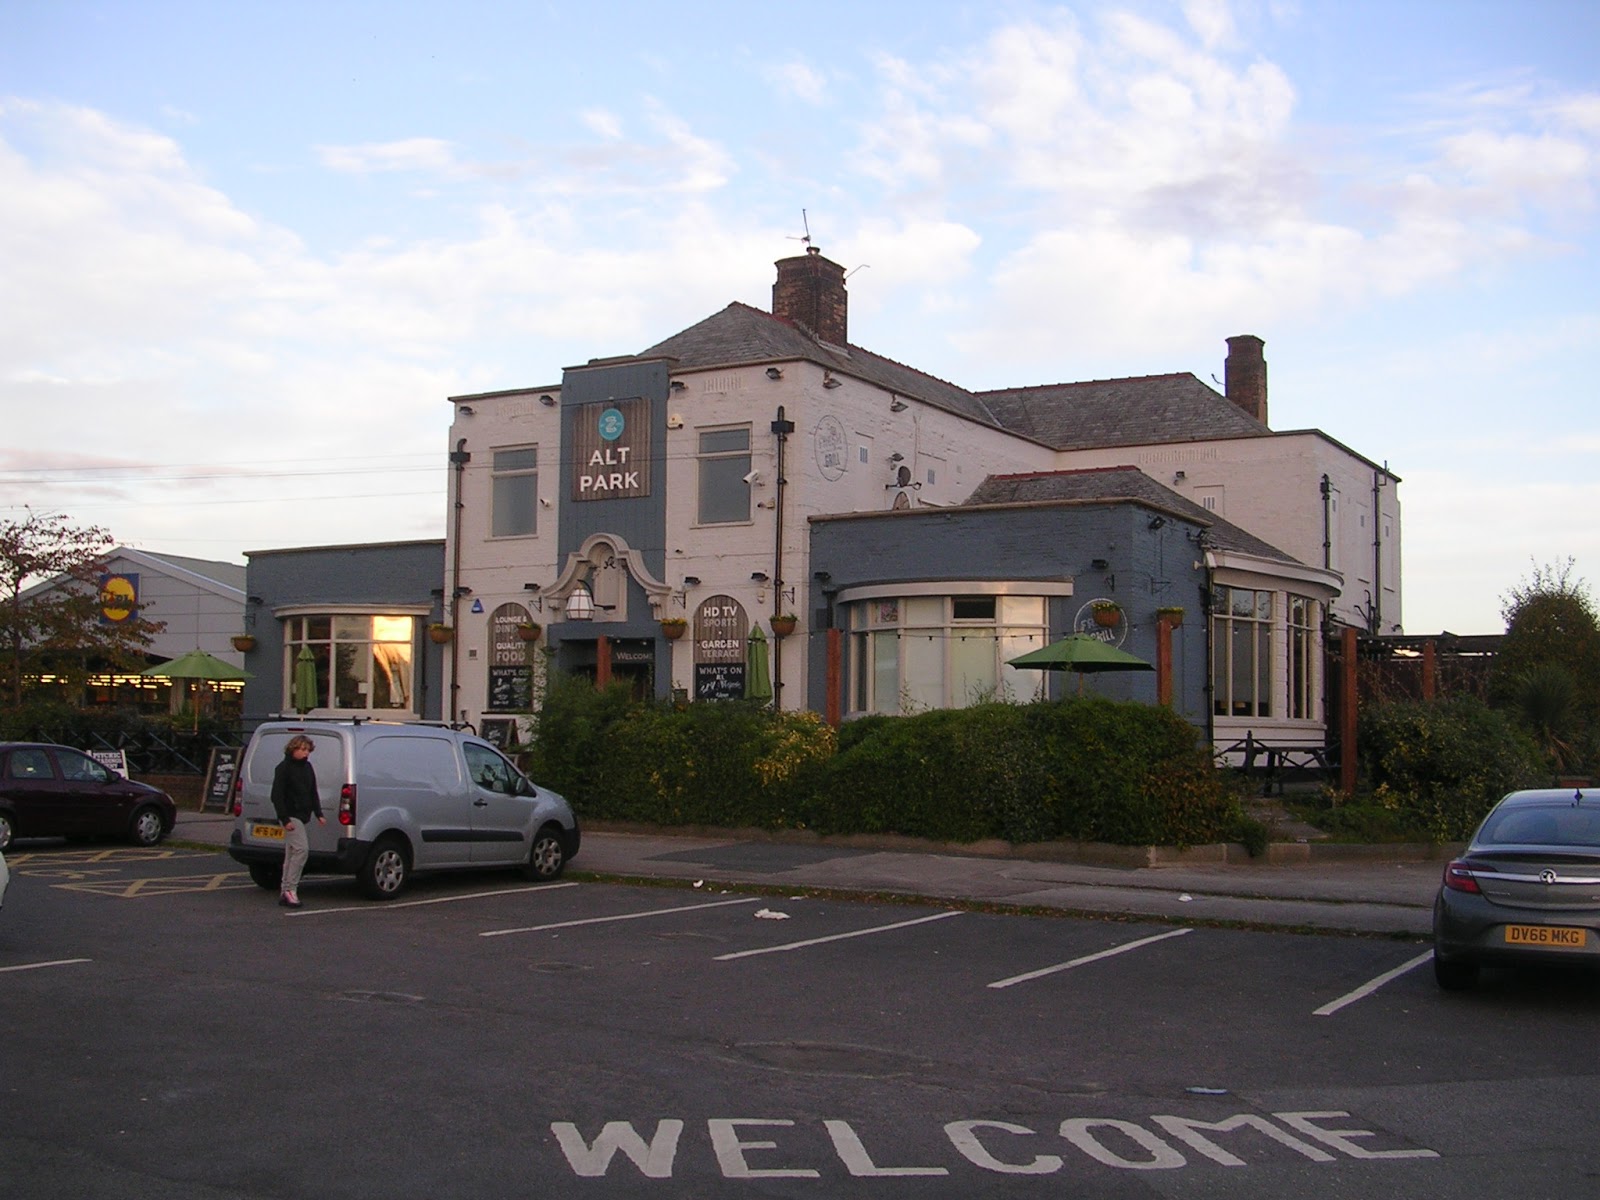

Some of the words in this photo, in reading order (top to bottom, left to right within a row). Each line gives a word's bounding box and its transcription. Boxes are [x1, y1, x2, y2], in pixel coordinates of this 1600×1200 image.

[588, 446, 630, 467] ALT
[580, 471, 639, 493] PARK
[703, 606, 720, 618] HD
[722, 605, 738, 617] TV
[495, 616, 521, 624] LOUNGE
[703, 617, 738, 628] SPORTS
[496, 641, 527, 650] QUALITY
[701, 639, 740, 649] GARDEN
[496, 651, 526, 662] FOOD
[701, 649, 740, 659] TERRACE
[699, 666, 728, 675] WHAT'S
[729, 666, 743, 675] ON
[1511, 927, 1548, 941] DV66
[1551, 930, 1580, 944] MKG
[549, 1108, 1440, 1180] WELCOME
